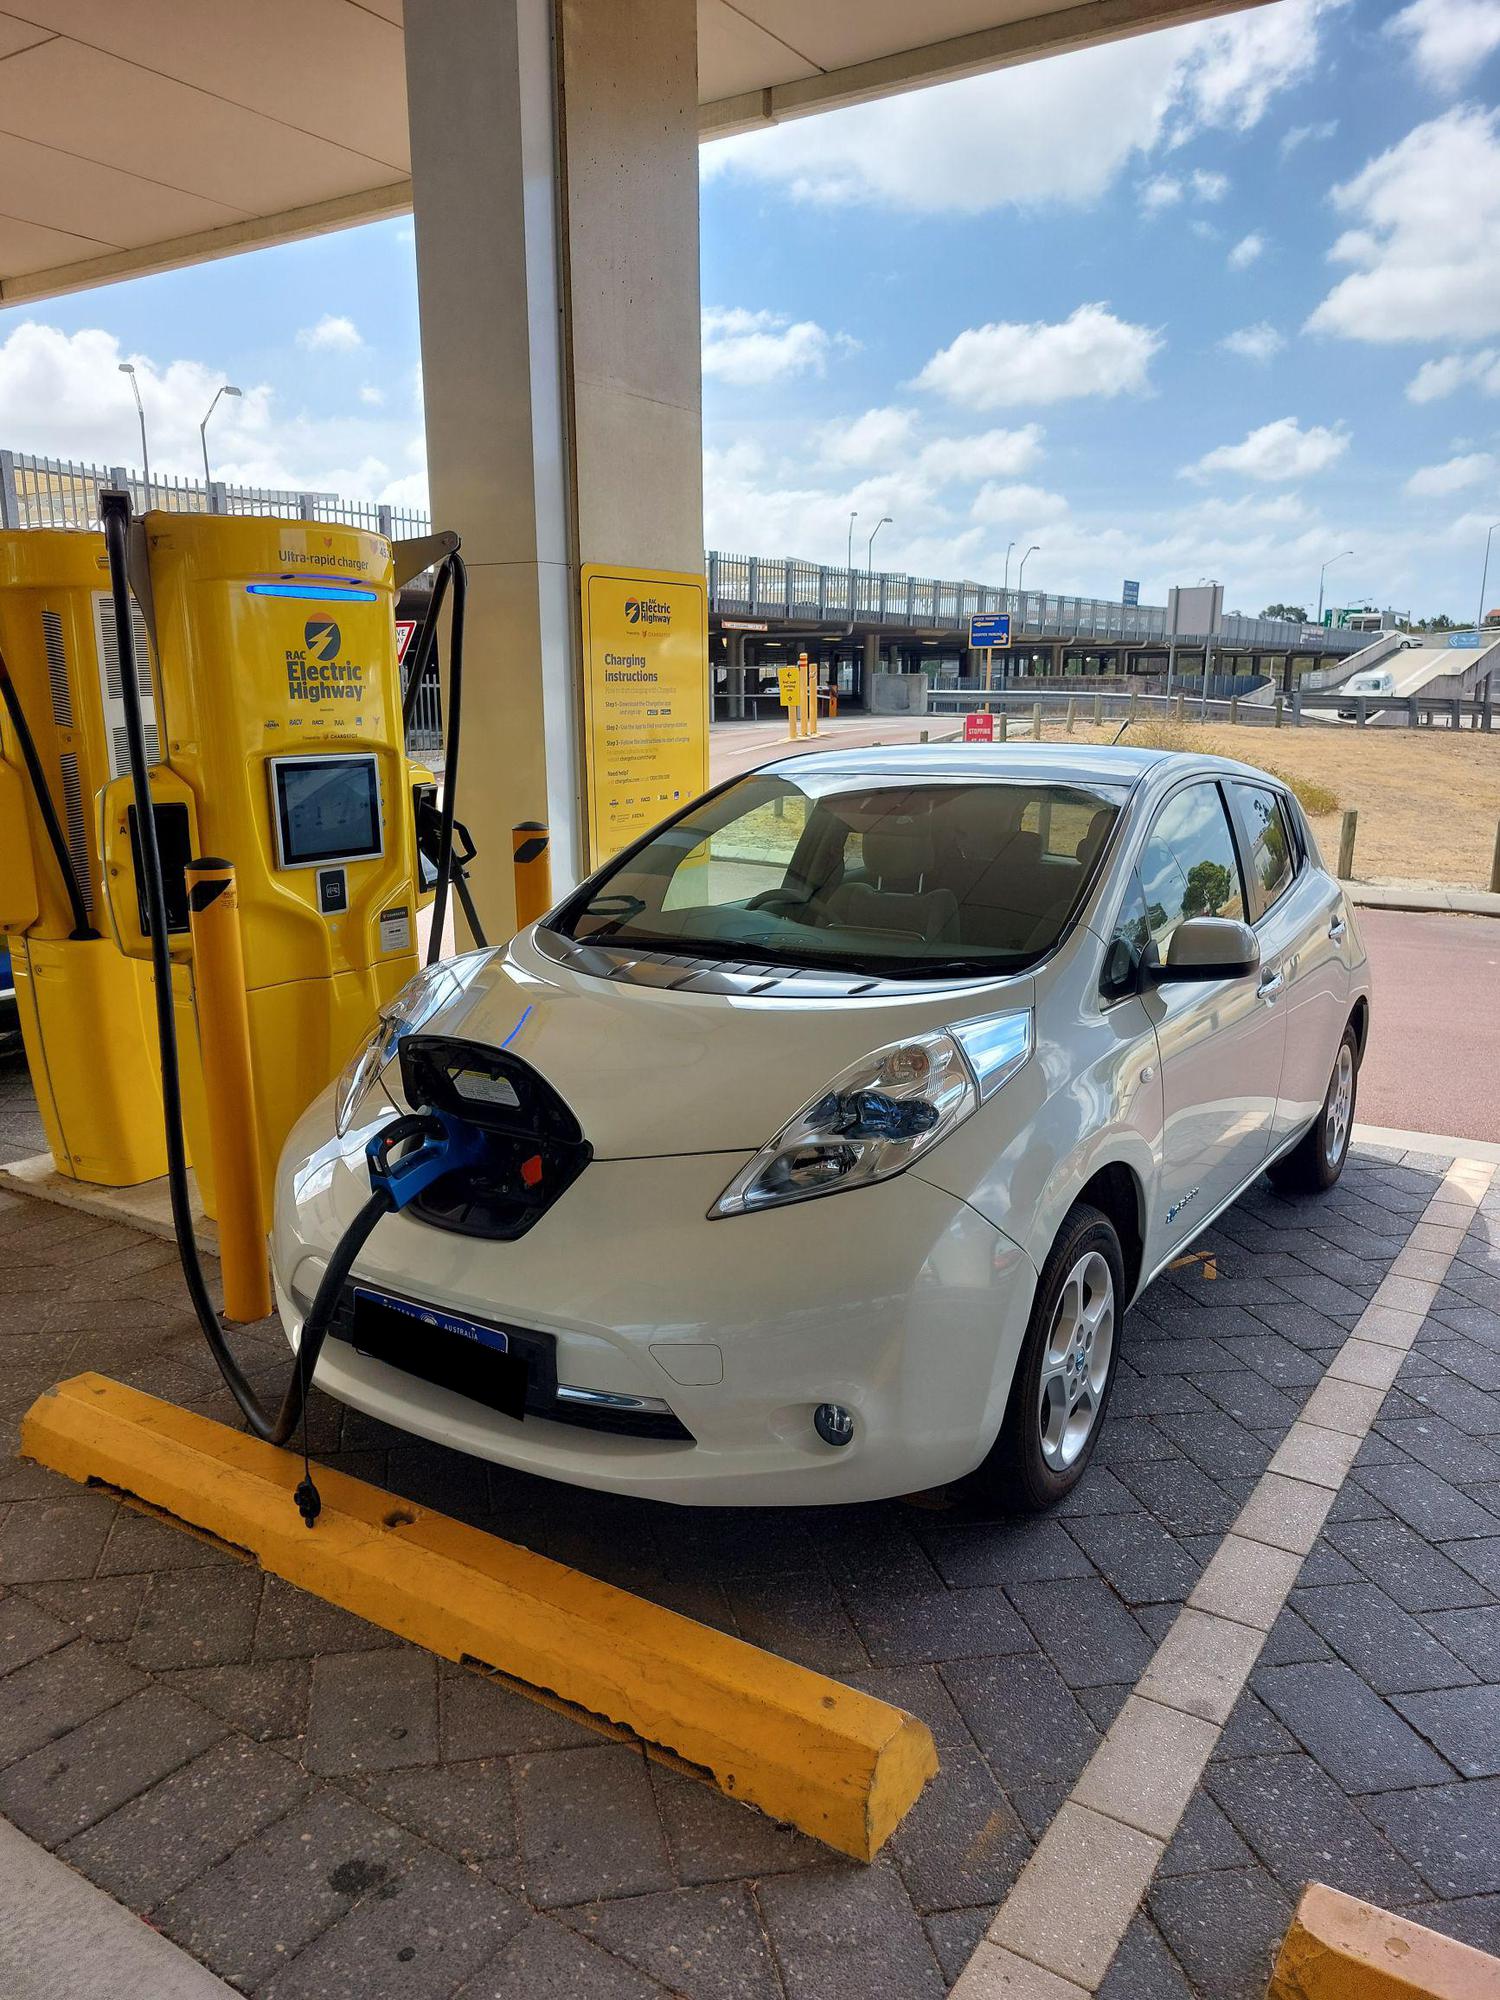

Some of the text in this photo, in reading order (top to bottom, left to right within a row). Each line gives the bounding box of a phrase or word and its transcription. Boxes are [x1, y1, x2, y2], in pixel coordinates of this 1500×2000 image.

[278, 550, 369, 571] Ultra-rapid charger
[641, 601, 671, 614] Electric
[641, 612, 671, 625] Highway
[285, 650, 306, 661] RAC
[604, 653, 646, 668] Charging
[287, 661, 362, 681] Electric
[605, 669, 658, 682] instructions
[289, 681, 363, 703] Highway
[119, 826, 127, 835] A
[444, 1324, 479, 1341] AUSTRALIA
